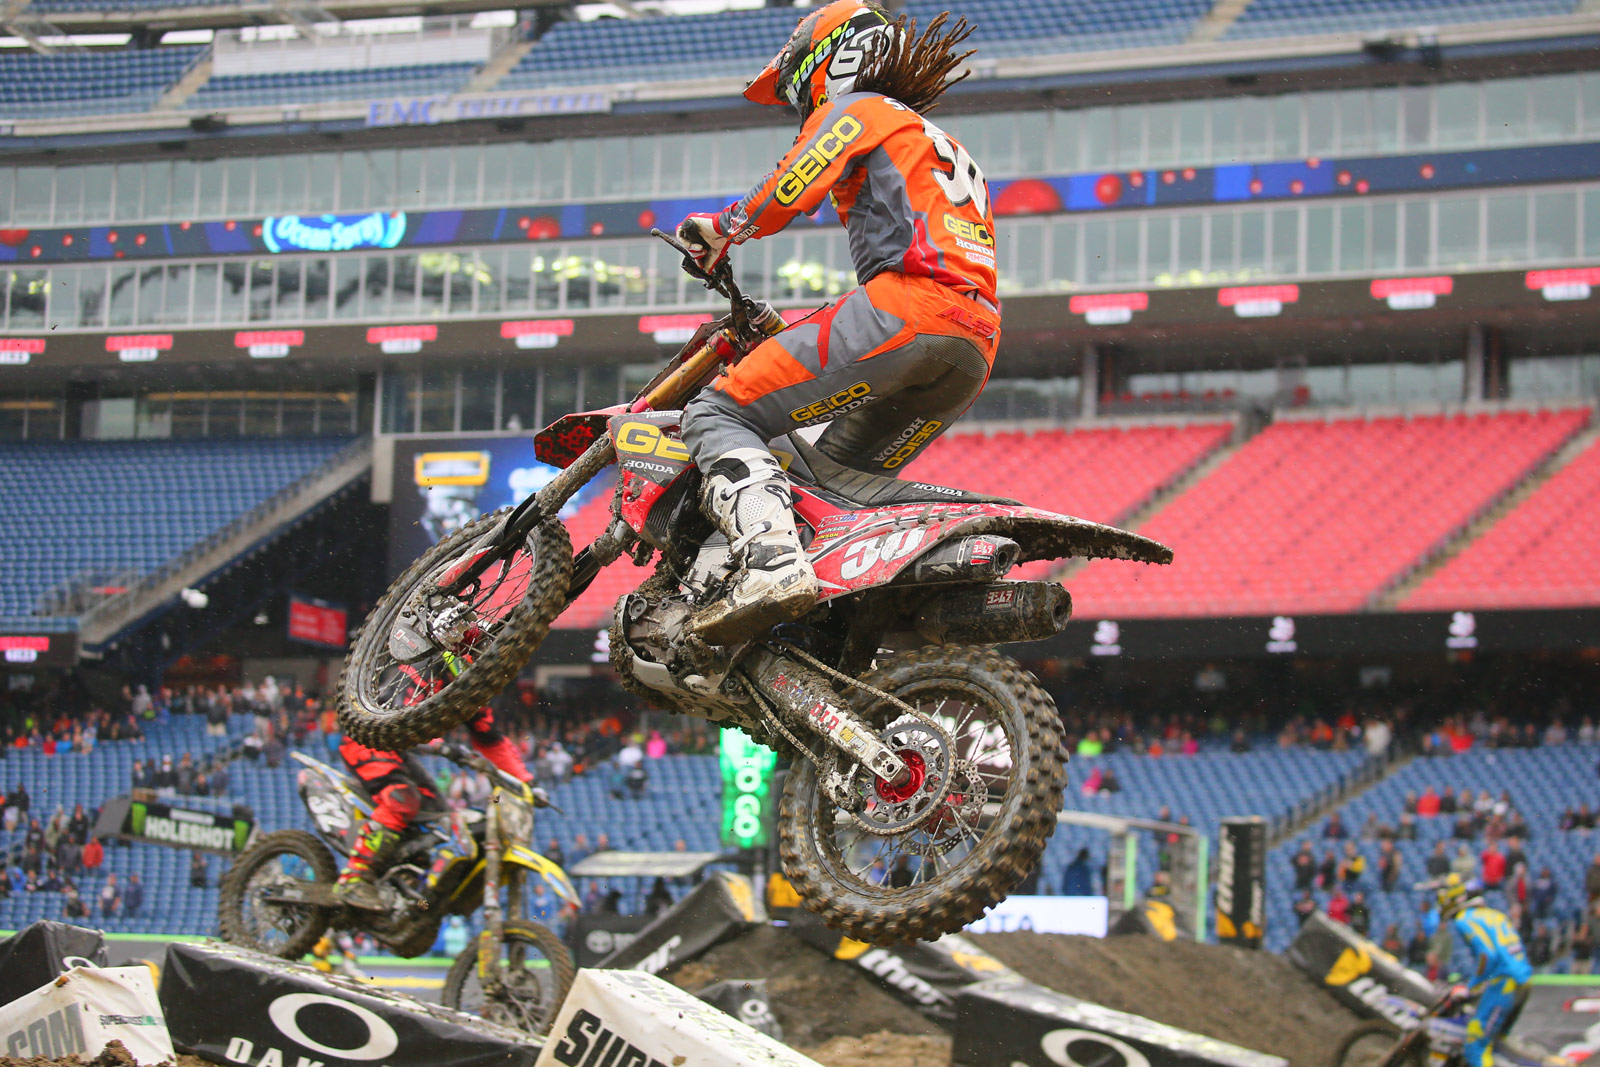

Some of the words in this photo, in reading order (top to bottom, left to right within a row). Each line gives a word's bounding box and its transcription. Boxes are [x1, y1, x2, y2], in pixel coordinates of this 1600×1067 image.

[792, 20, 855, 94] 100%
[775, 114, 863, 206] GEICO
[943, 213, 995, 247] GEICO
[790, 381, 872, 422] GEICO
[805, 395, 879, 426] HONDA
[872, 417, 927, 462] HONDA
[883, 420, 943, 469] GEICO
[623, 459, 676, 475] HONDA
[911, 482, 965, 498] HONDA
[144, 815, 236, 851] HOLESHOT
